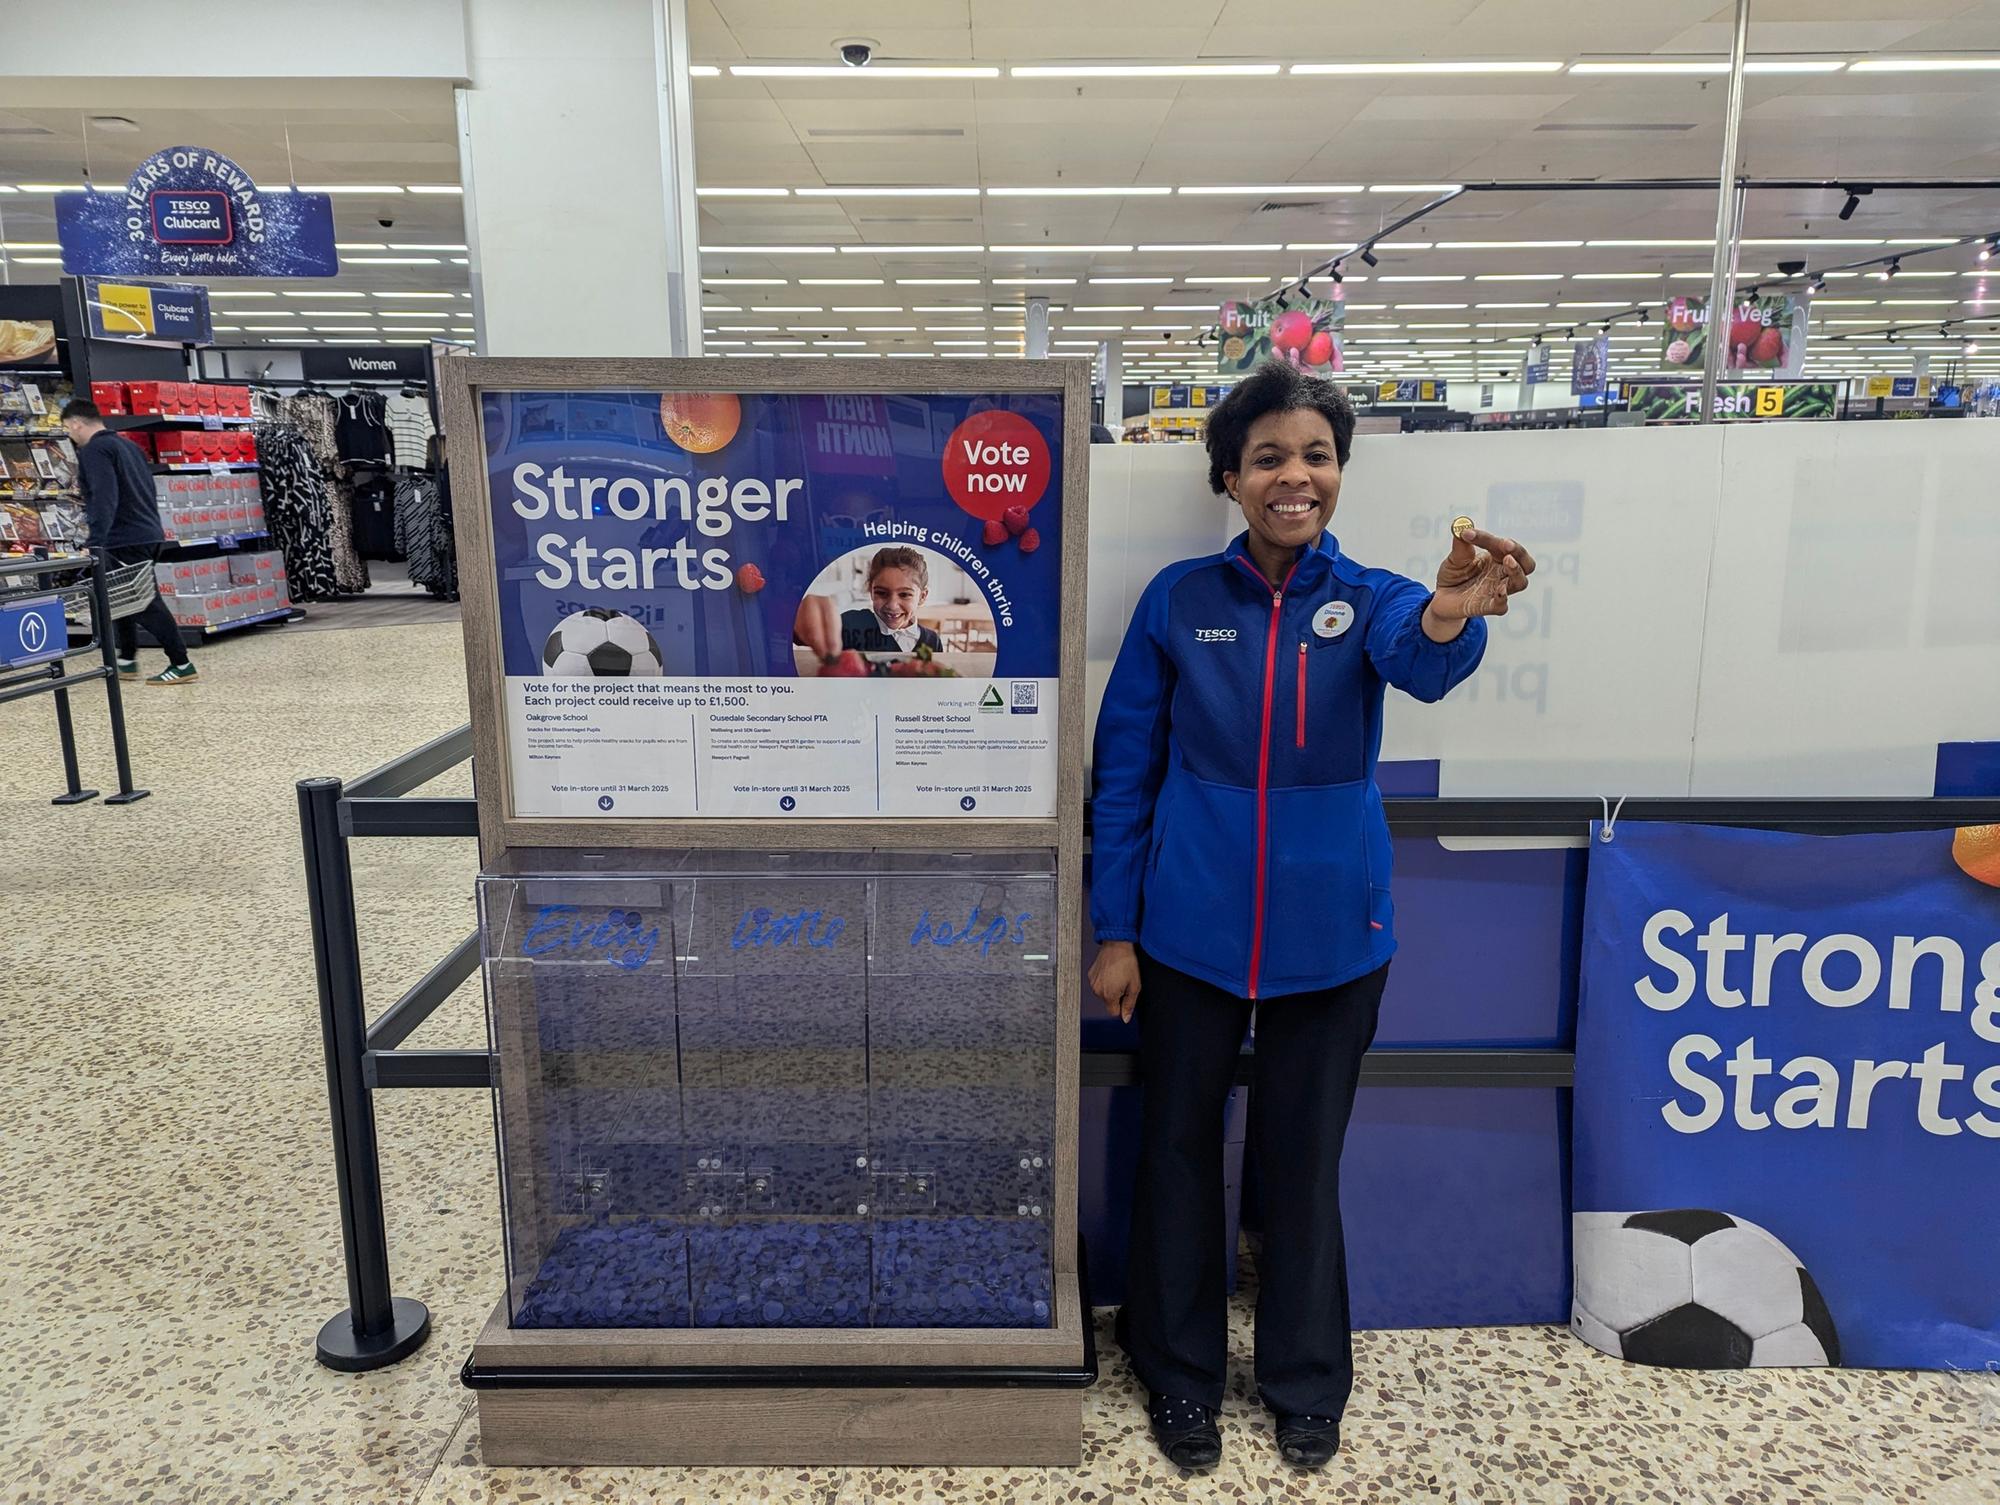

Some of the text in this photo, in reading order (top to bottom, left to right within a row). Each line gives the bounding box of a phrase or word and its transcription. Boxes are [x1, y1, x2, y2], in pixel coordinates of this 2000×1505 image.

[127, 152, 264, 243] 30 YEARS OF REWARDS
[169, 200, 210, 212] TESCO
[163, 216, 220, 229] Clubcard
[157, 303, 194, 314] Clubcard
[164, 312, 190, 322] Prices
[1226, 310, 1270, 328] Fruit
[1672, 305, 1773, 326] Frui Veg
[347, 357, 397, 370] Women
[1685, 391, 1777, 413] Fesh 5
[963, 440, 1030, 466] Vote
[967, 471, 1027, 493] now
[512, 462, 804, 537] Stronger
[535, 533, 734, 590] Starts
[863, 520, 1013, 627] Helping children thrive
[1195, 628, 1237, 641] TESCO
[523, 683, 795, 696] Vote for the project that means the most to you.
[524, 696, 749, 708] Each project could receive up to £1,500.
[525, 713, 588, 723] Oakgrove School
[709, 714, 828, 724] Ousedale Secondary School PTA
[895, 714, 971, 722] Russell Street School
[522, 905, 1033, 970] Every little helps
